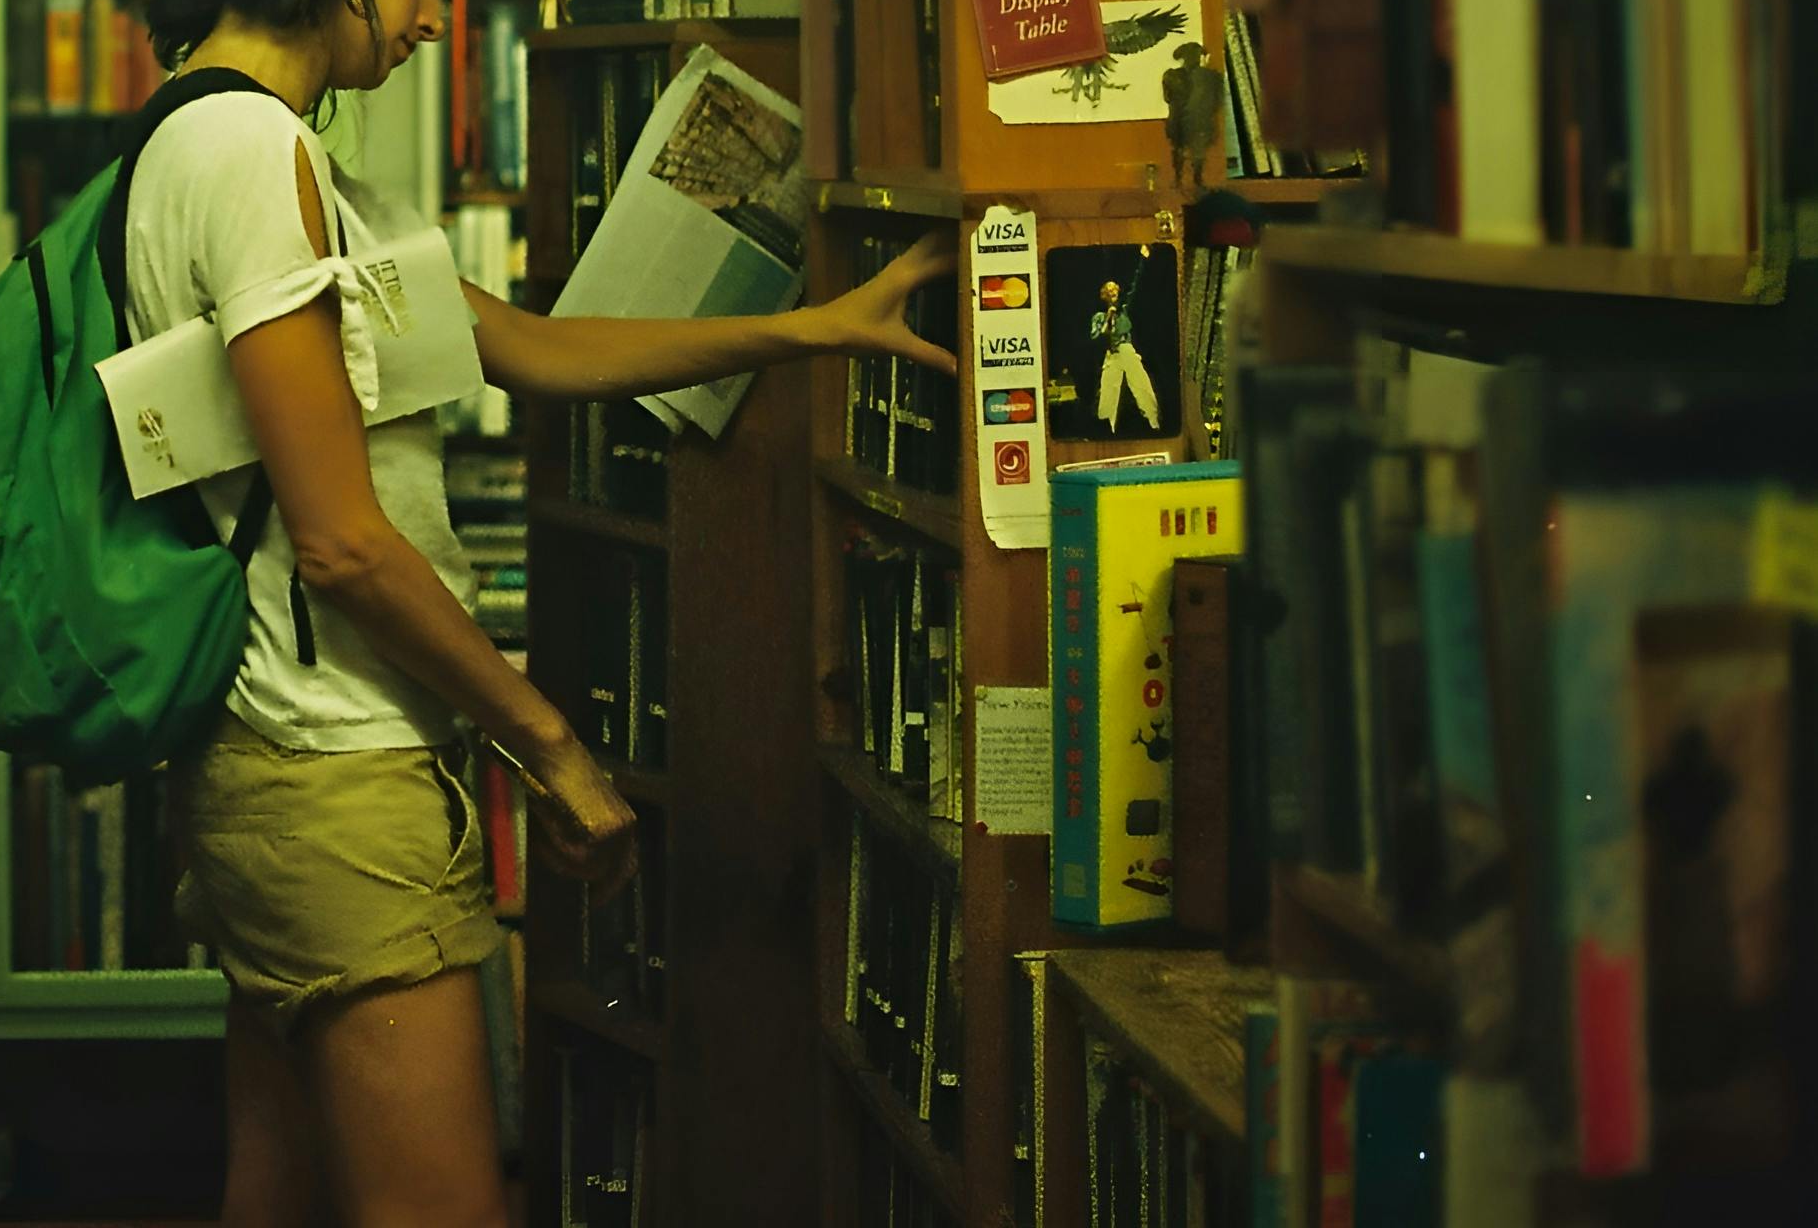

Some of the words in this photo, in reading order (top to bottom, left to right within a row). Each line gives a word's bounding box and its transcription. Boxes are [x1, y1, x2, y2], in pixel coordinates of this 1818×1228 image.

[1014, 14, 1069, 42] Table
[983, 222, 1026, 241] VISA
[988, 336, 1032, 355] VISA
